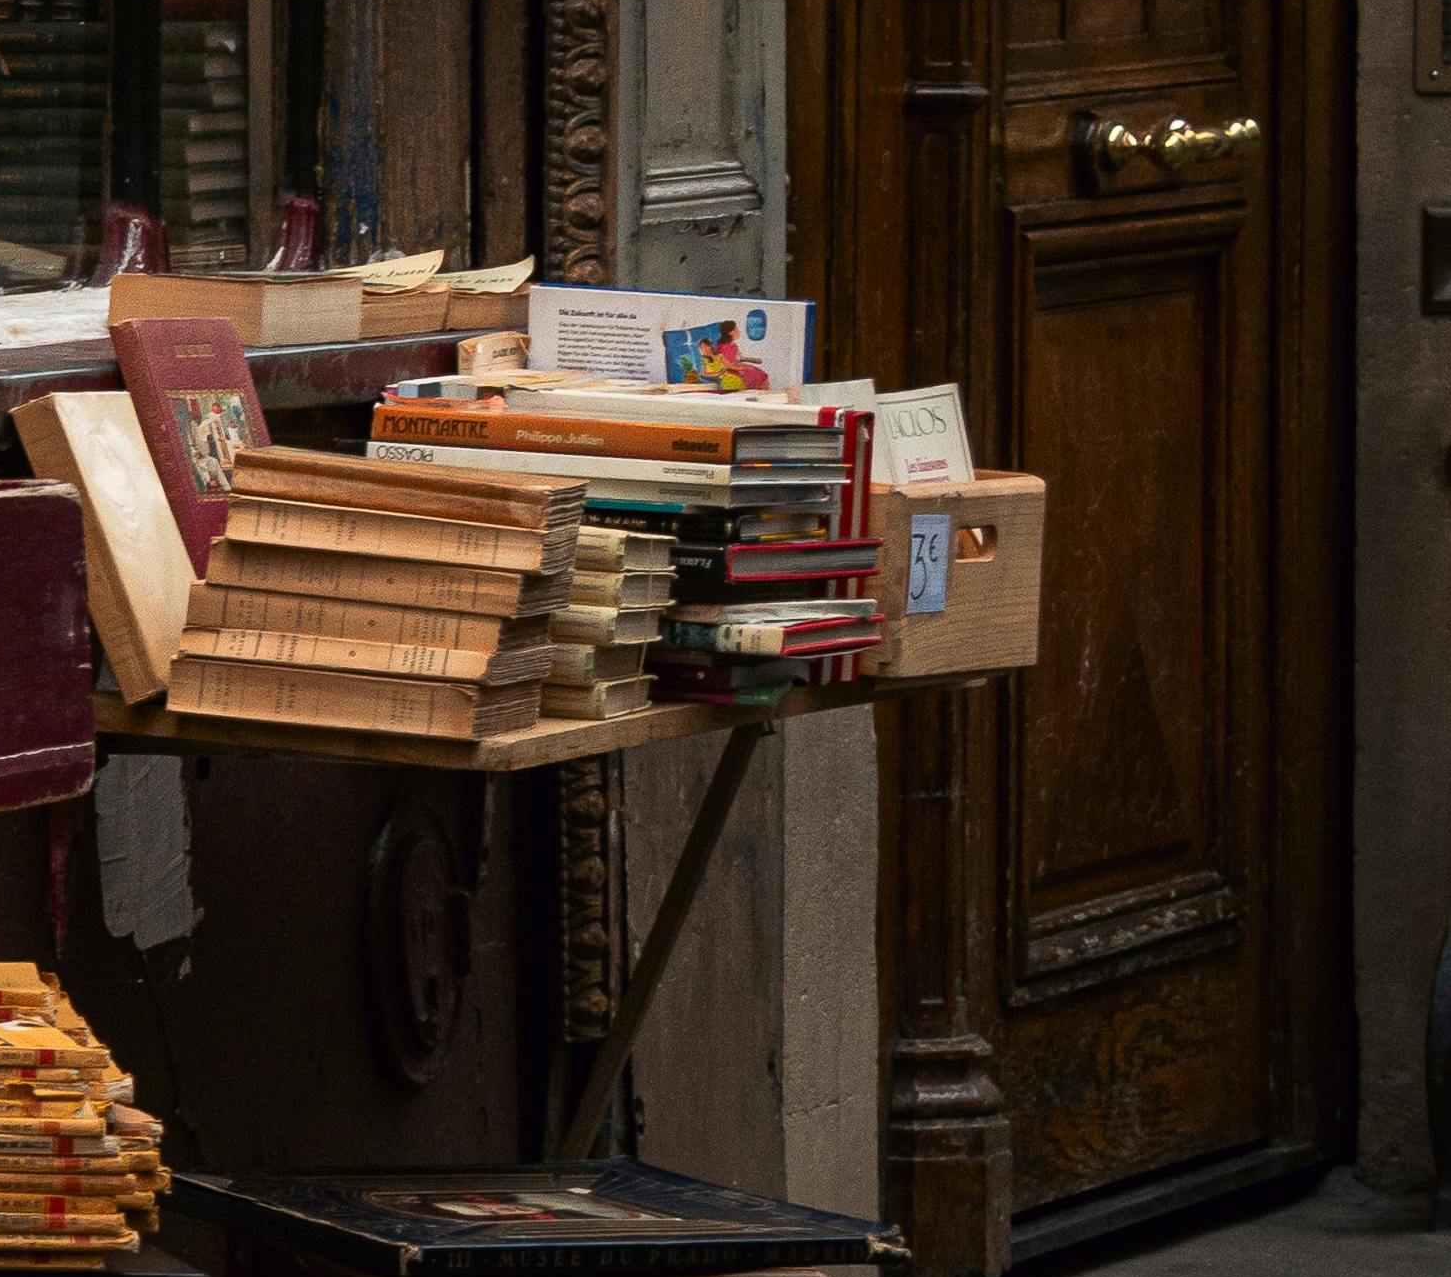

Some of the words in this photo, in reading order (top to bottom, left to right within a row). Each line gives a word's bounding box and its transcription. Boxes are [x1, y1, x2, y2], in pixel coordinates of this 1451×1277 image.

[383, 415, 489, 439] MONTMARTRE
[515, 429, 564, 445] Philippe
[376, 444, 434, 463] PICASSO
[600, 1248, 632, 1268] DU
[648, 1245, 740, 1267] PRADO
